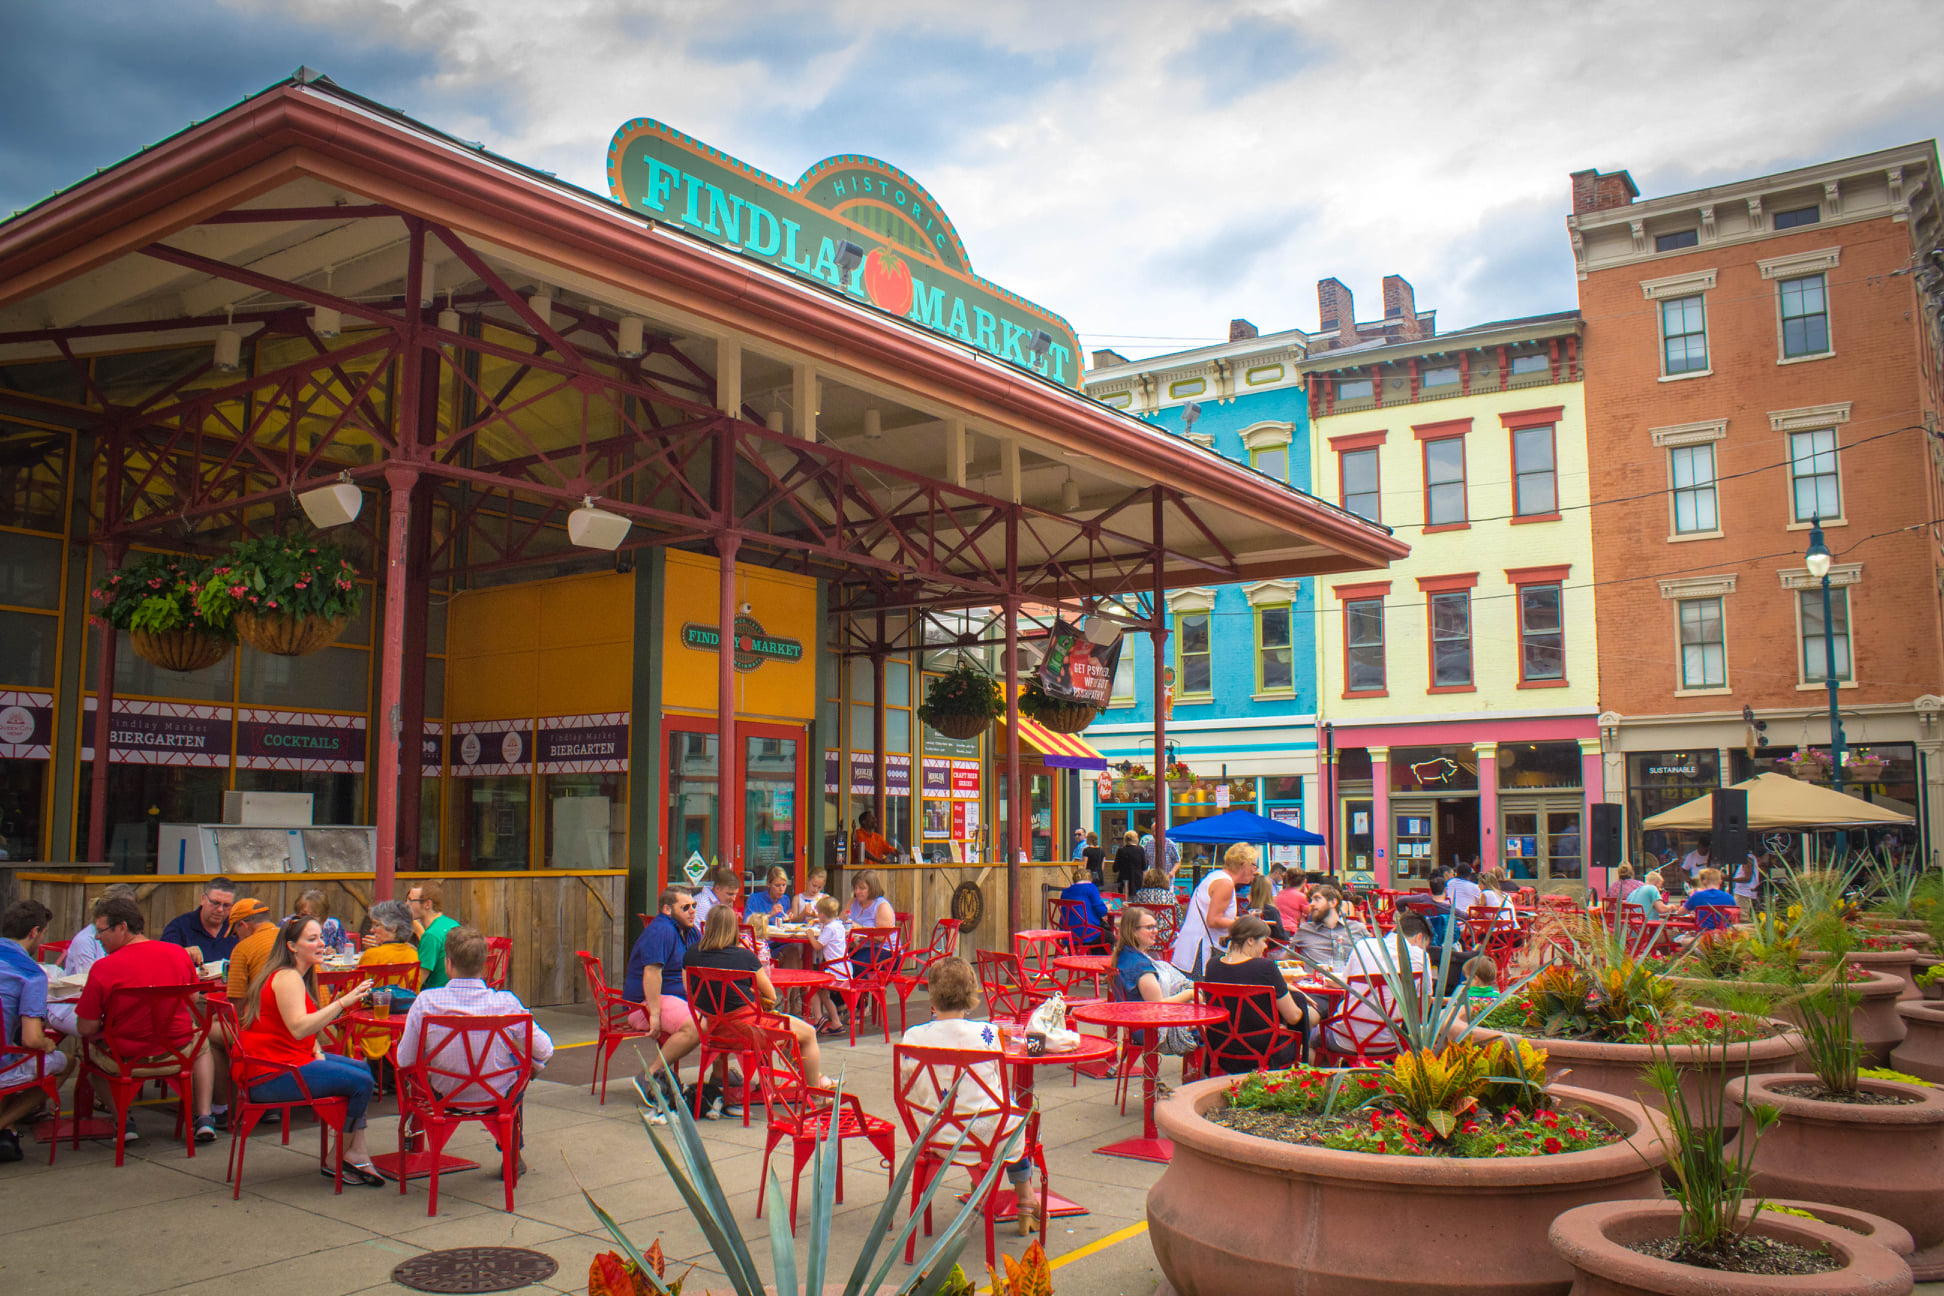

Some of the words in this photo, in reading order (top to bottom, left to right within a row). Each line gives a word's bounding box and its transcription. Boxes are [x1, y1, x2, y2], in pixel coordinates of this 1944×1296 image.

[832, 176, 946, 249] HISTORIC
[642, 155, 866, 298] FINDLAY
[752, 639, 801, 657] MARKET
[1073, 662, 1085, 674] GET
[165, 721, 207, 732] Market
[110, 730, 206, 748] BIERGARTEN
[264, 734, 339, 750] COCKTAILS
[550, 742, 615, 756] BIERGARTEN
[1648, 766, 1697, 774] SUSTAINABLE
